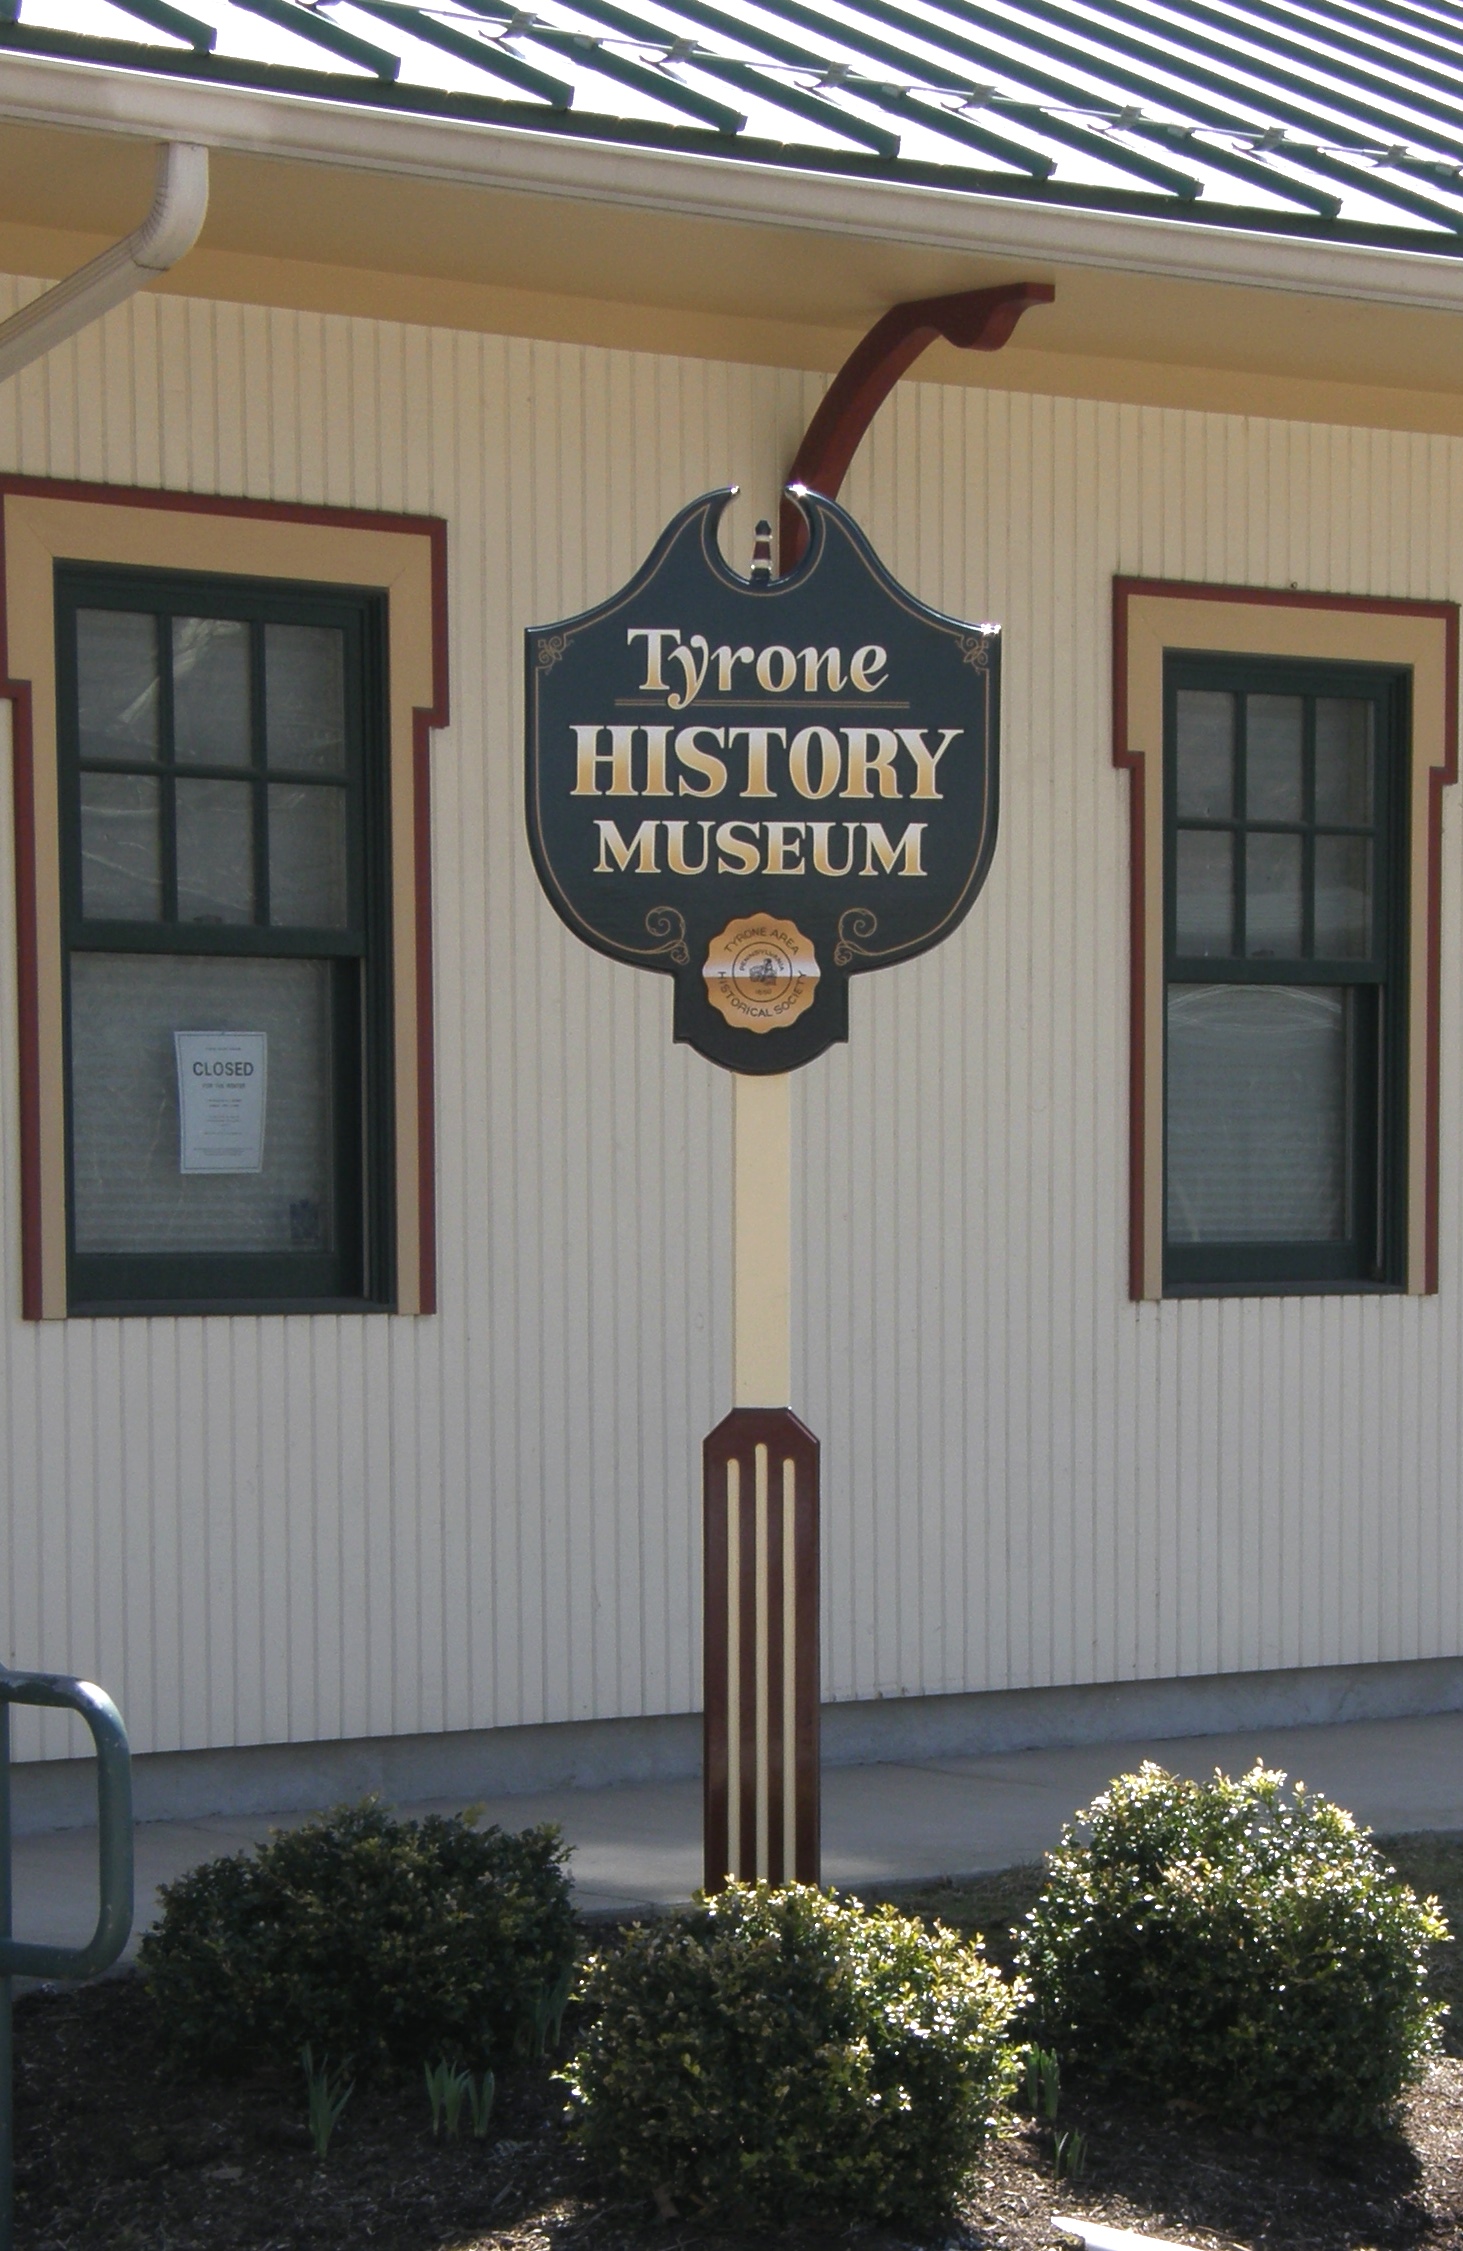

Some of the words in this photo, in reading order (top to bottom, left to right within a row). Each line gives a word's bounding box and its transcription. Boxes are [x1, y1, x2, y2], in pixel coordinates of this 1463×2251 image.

[627, 628, 889, 710] Tyrone
[569, 725, 964, 800] HISTORY
[593, 820, 928, 876] MUSEUM
[724, 927, 767, 953] TYRONE
[770, 929, 800, 956] AREA
[739, 949, 784, 971] PENNSYLVANIA
[718, 971, 773, 1018] HISTORICAL
[774, 970, 806, 1015] SOCIETY
[193, 1061, 254, 1076] CLOSED
